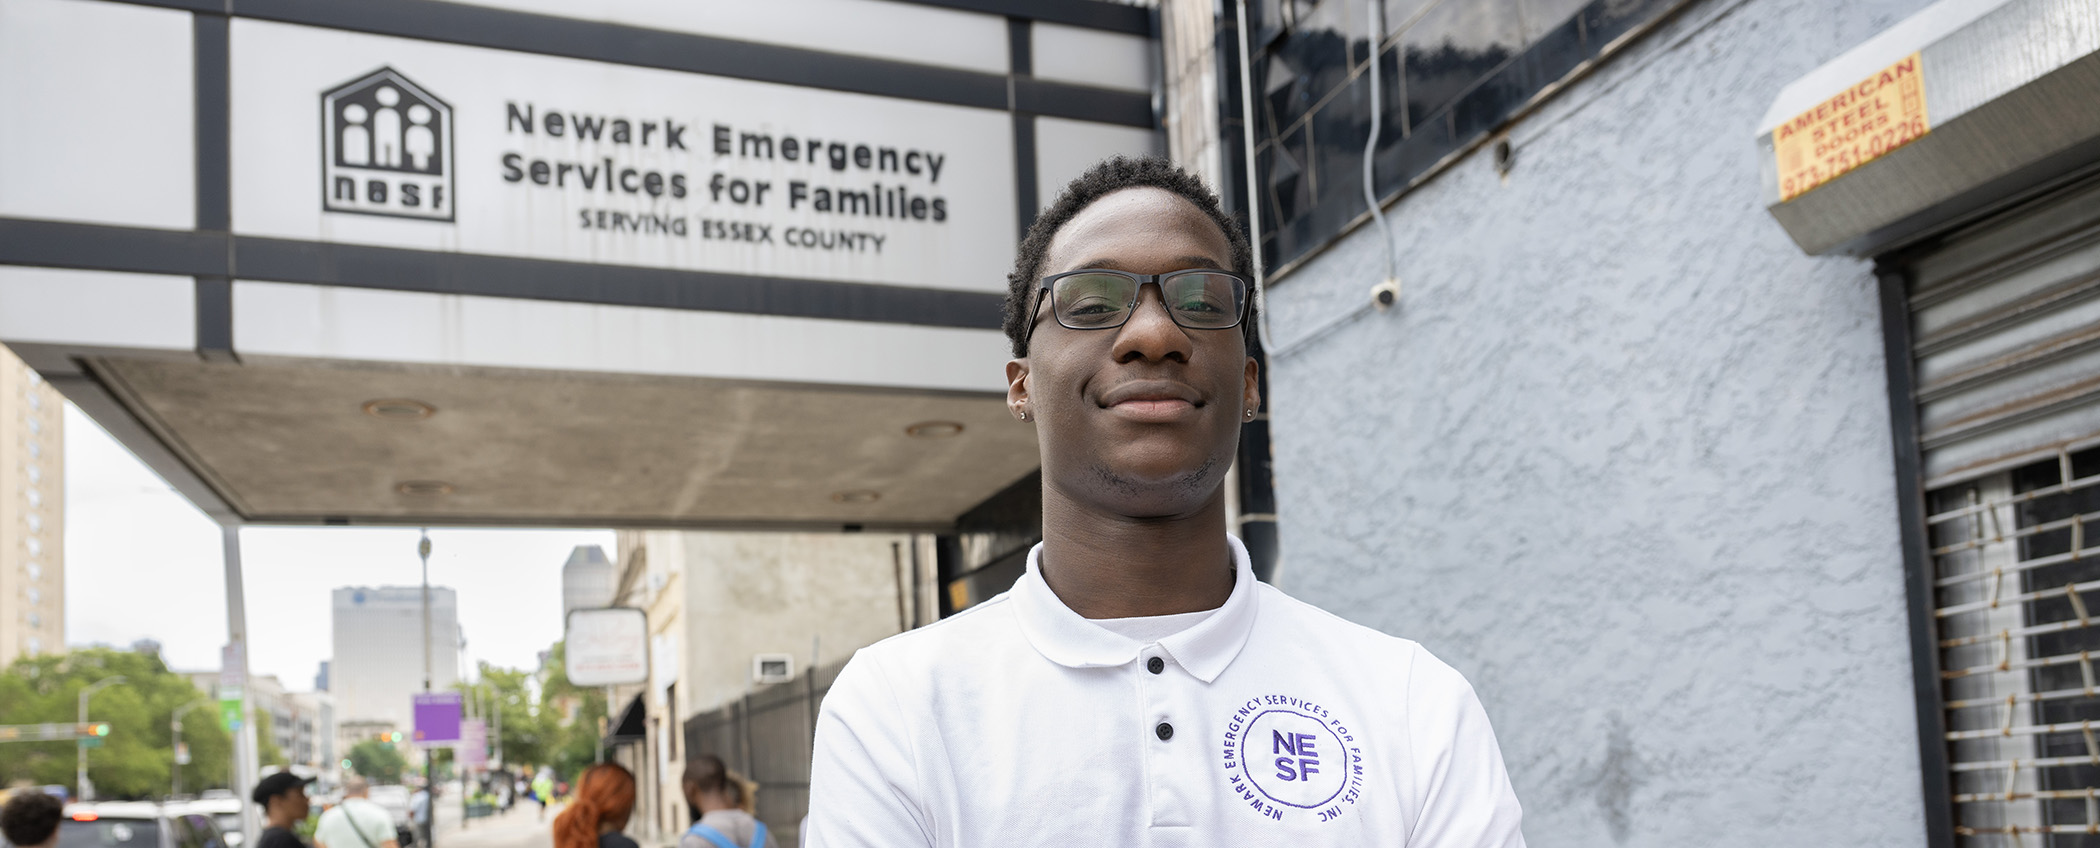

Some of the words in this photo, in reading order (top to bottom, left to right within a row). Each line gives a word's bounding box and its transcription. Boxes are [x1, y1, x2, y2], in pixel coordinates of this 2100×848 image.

[1779, 57, 1915, 141] AMERICAN
[1812, 97, 1889, 142] STEEL
[507, 102, 687, 151] Newark
[713, 124, 944, 183] Emergency
[1783, 114, 1925, 200] 973-751-0226
[1815, 112, 1889, 157] DOORS
[502, 153, 687, 199] Services
[710, 173, 770, 206] for
[789, 180, 947, 222] Families
[579, 208, 687, 237] SERVING
[702, 219, 773, 244] ESSEX
[784, 227, 885, 254] COUNTY
[1265, 695, 1329, 718] SERVICES
[1224, 697, 1262, 769] EMERGENCY
[1272, 729, 1319, 758] NE
[1330, 719, 1354, 742] FOR
[1274, 757, 1320, 782] SF
[1230, 774, 1283, 821] NEWARK
[1317, 805, 1343, 822] INC
